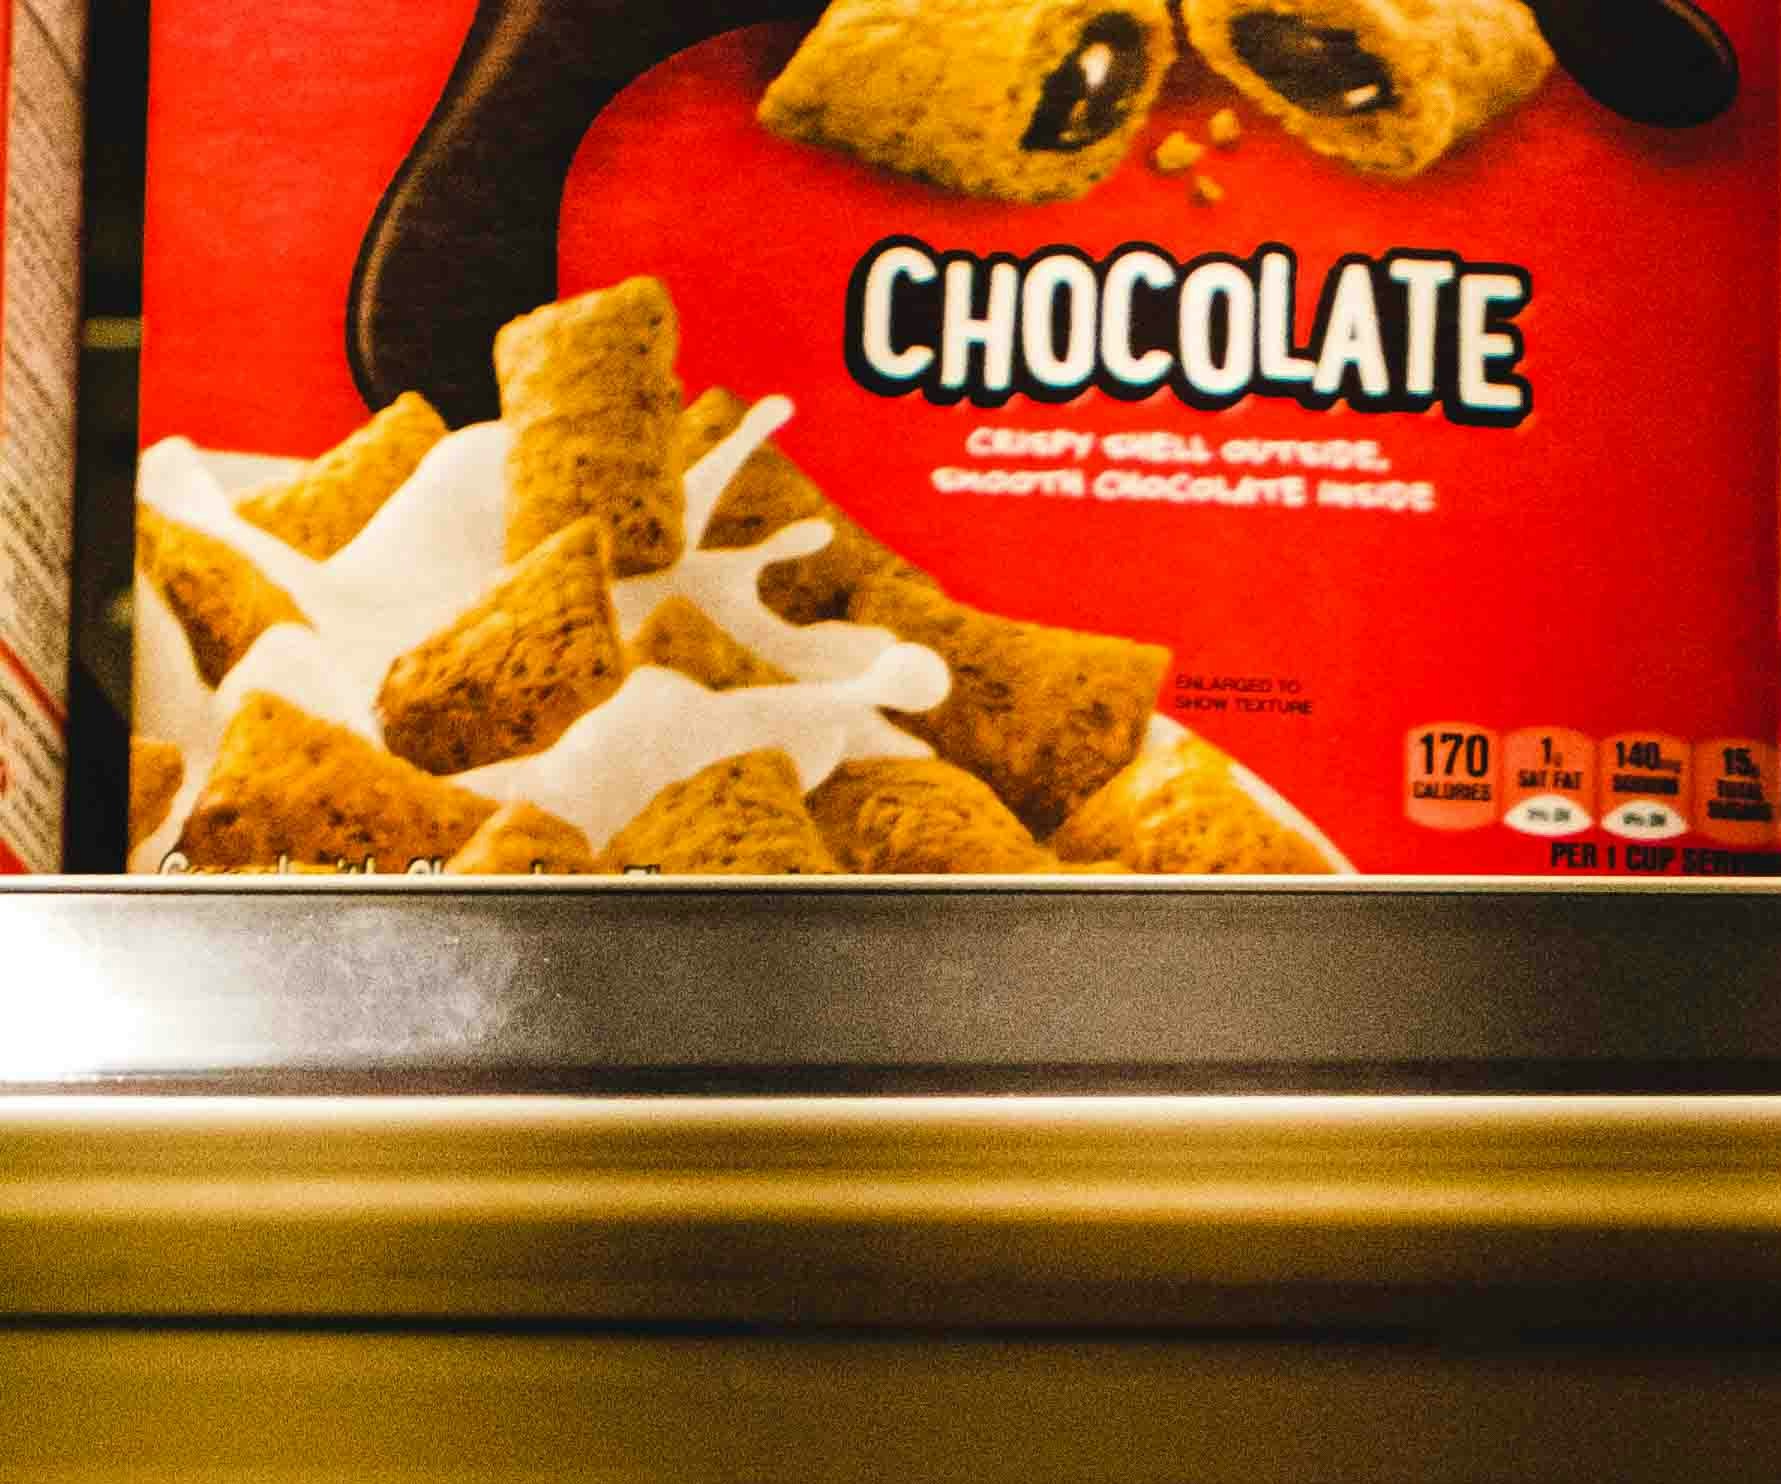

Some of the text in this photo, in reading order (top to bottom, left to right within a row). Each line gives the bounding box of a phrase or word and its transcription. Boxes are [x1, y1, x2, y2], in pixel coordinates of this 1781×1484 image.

[856, 242, 1526, 412] CHOCOLATE
[1093, 470, 1306, 506] CHOCOLATE
[1420, 733, 1489, 777] 170
